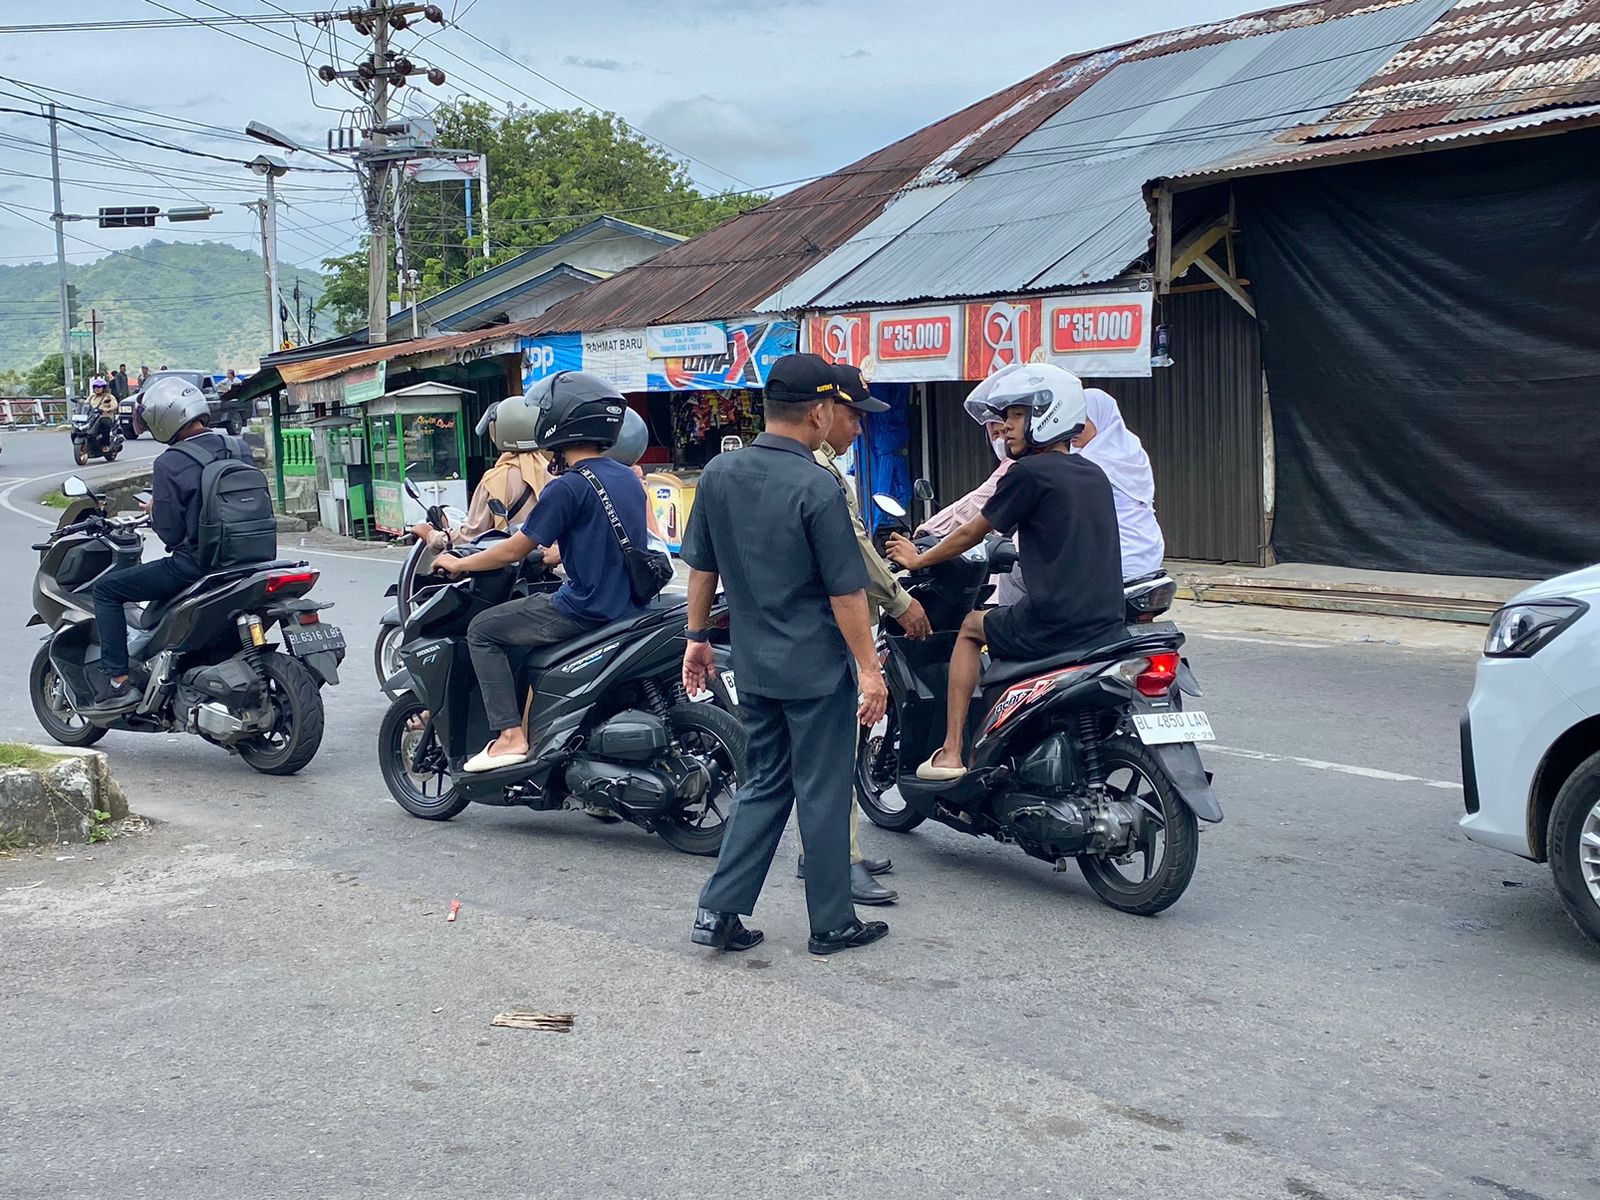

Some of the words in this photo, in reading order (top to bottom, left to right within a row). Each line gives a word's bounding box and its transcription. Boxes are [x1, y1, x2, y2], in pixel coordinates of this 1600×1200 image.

[1072, 310, 1132, 343] 35.000
[894, 322, 943, 351] 35.000
[586, 340, 618, 353] RAHMAT
[619, 338, 643, 351] BARU
[300, 630, 323, 642] 6516
[1136, 716, 1153, 730] BL
[1157, 713, 1184, 729] 4850
[1185, 713, 1209, 727] LAN
